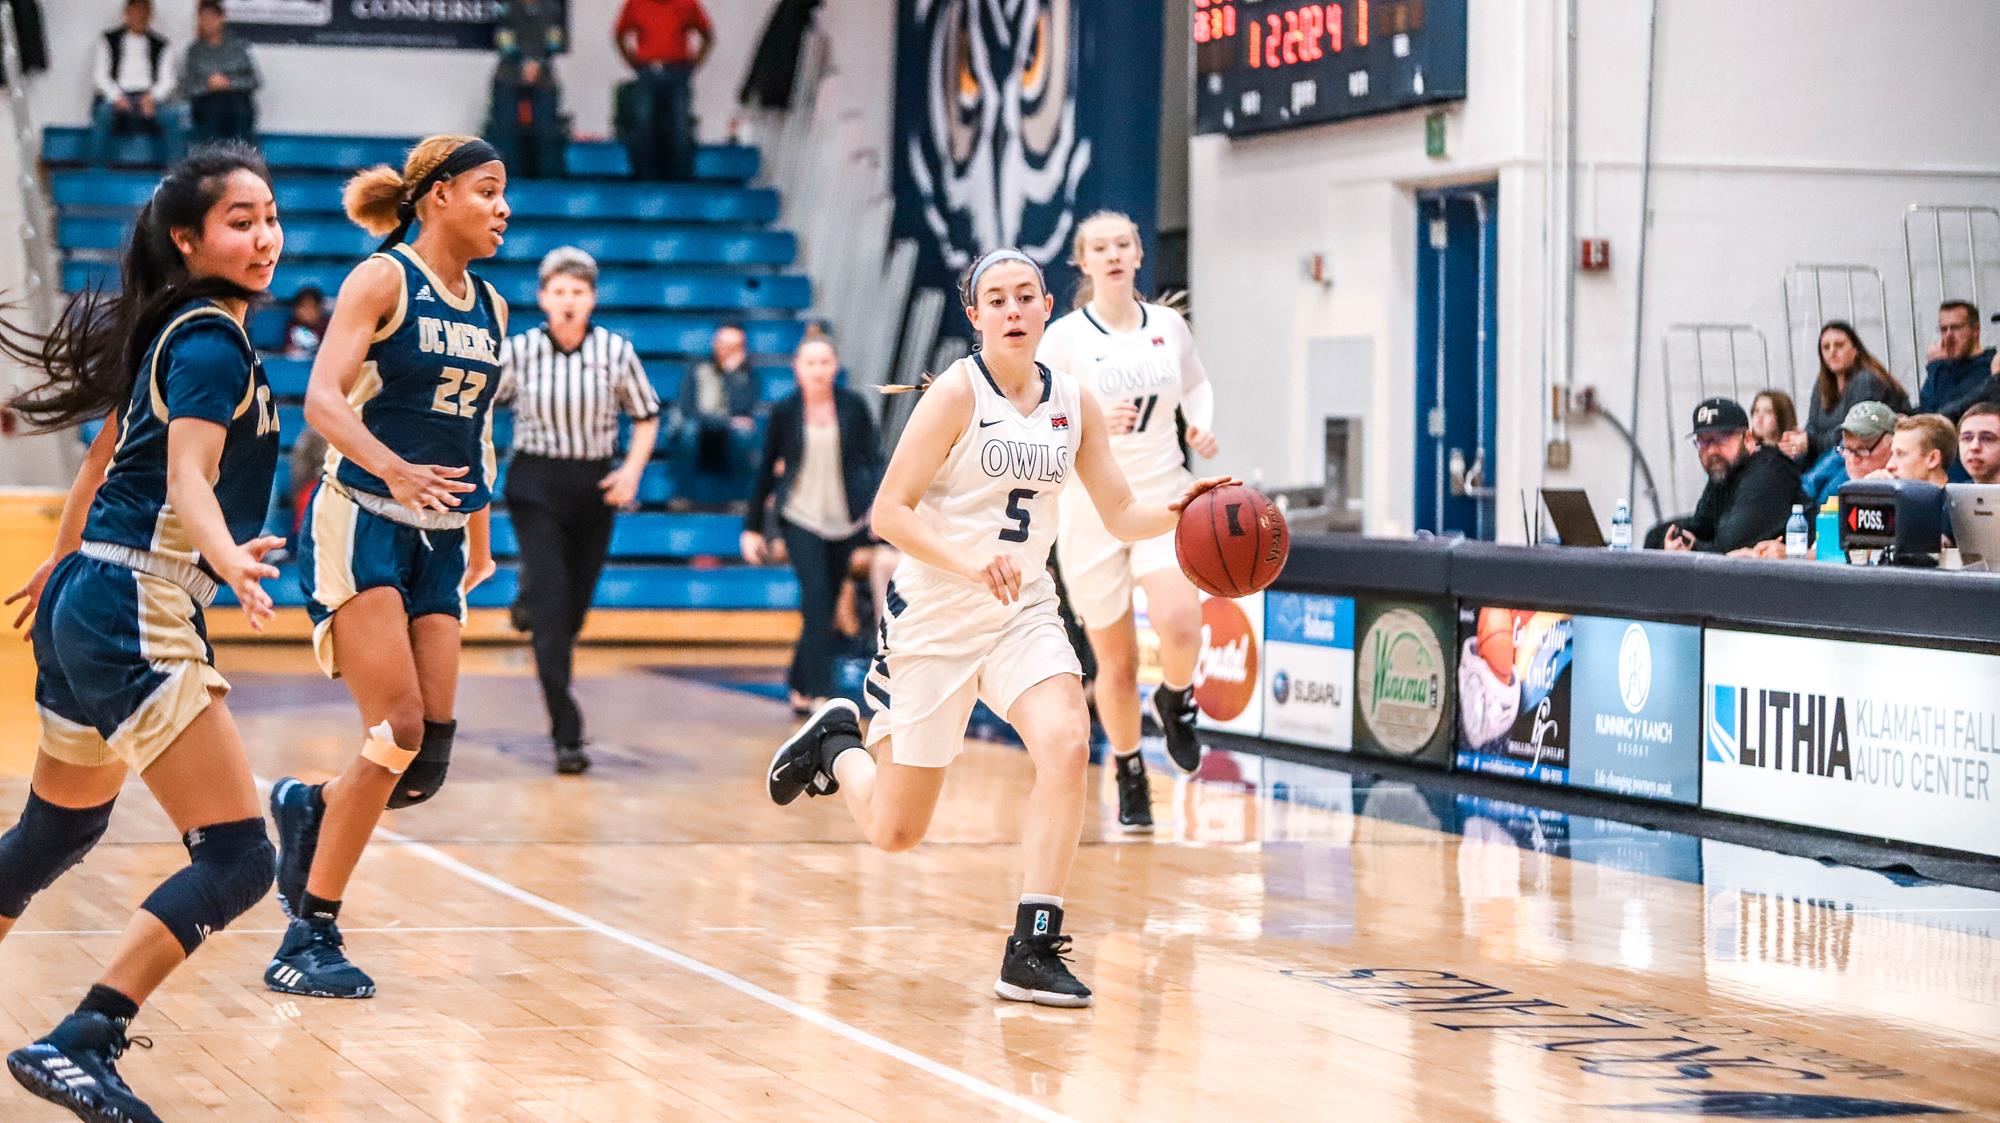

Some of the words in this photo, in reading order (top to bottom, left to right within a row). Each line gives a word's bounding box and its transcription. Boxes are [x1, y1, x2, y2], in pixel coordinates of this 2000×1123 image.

[417, 316, 445, 354] UC
[431, 366, 488, 419] 22
[980, 438, 1069, 484] OWLS
[997, 488, 1039, 543] 5
[1858, 509, 1885, 531] POSS.
[1294, 680, 1342, 707] SUBARU
[1595, 713, 1633, 739] RUNNING
[1642, 719, 1672, 744] RANCH
[1740, 686, 1852, 781] LITHIA
[1856, 698, 1947, 749] KLAMATH
[1855, 744, 1905, 788] AUTO
[1911, 753, 1990, 801] CENTER
